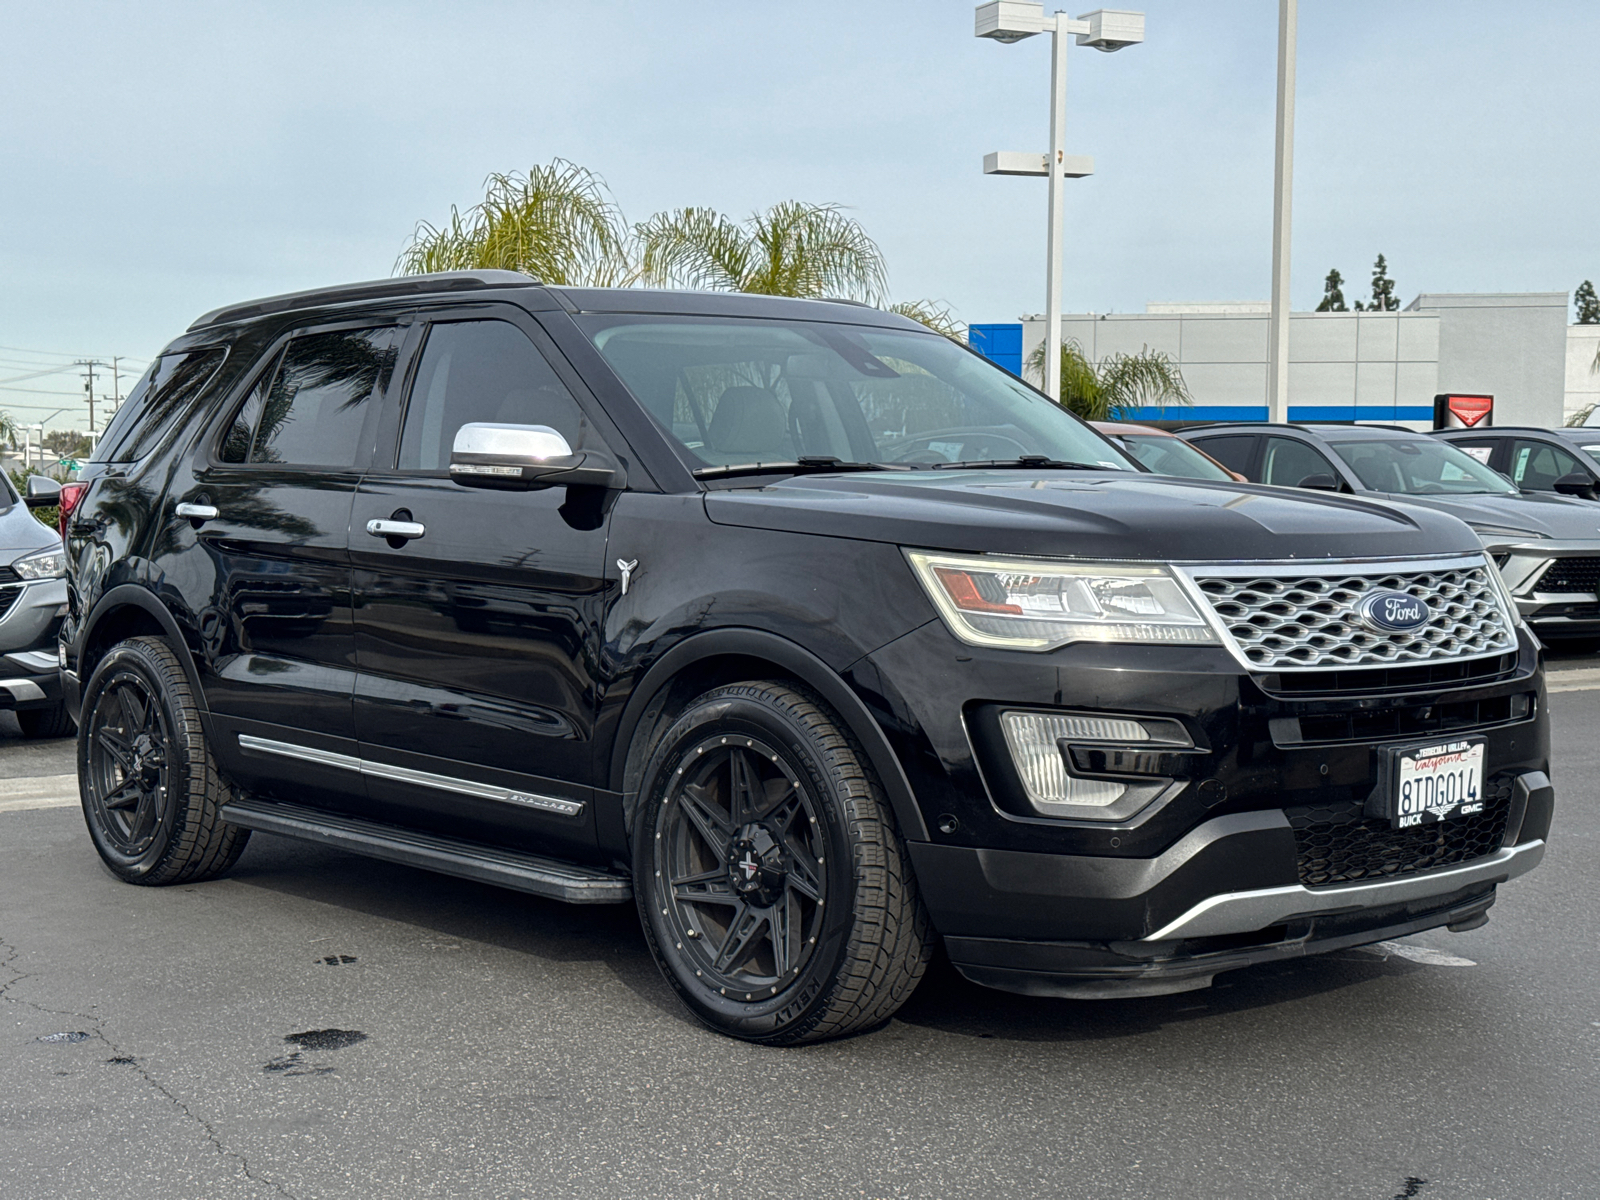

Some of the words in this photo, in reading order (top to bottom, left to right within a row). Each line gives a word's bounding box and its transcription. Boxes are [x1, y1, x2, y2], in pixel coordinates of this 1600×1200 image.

[1385, 598, 1421, 621] Ford
[1416, 754, 1468, 772] California
[1402, 768, 1476, 813] 8TDG014
[510, 794, 574, 812] EXPLORER
[1399, 814, 1422, 828] BUICK
[1461, 803, 1483, 814] GMC
[772, 974, 820, 1026] KELLY
